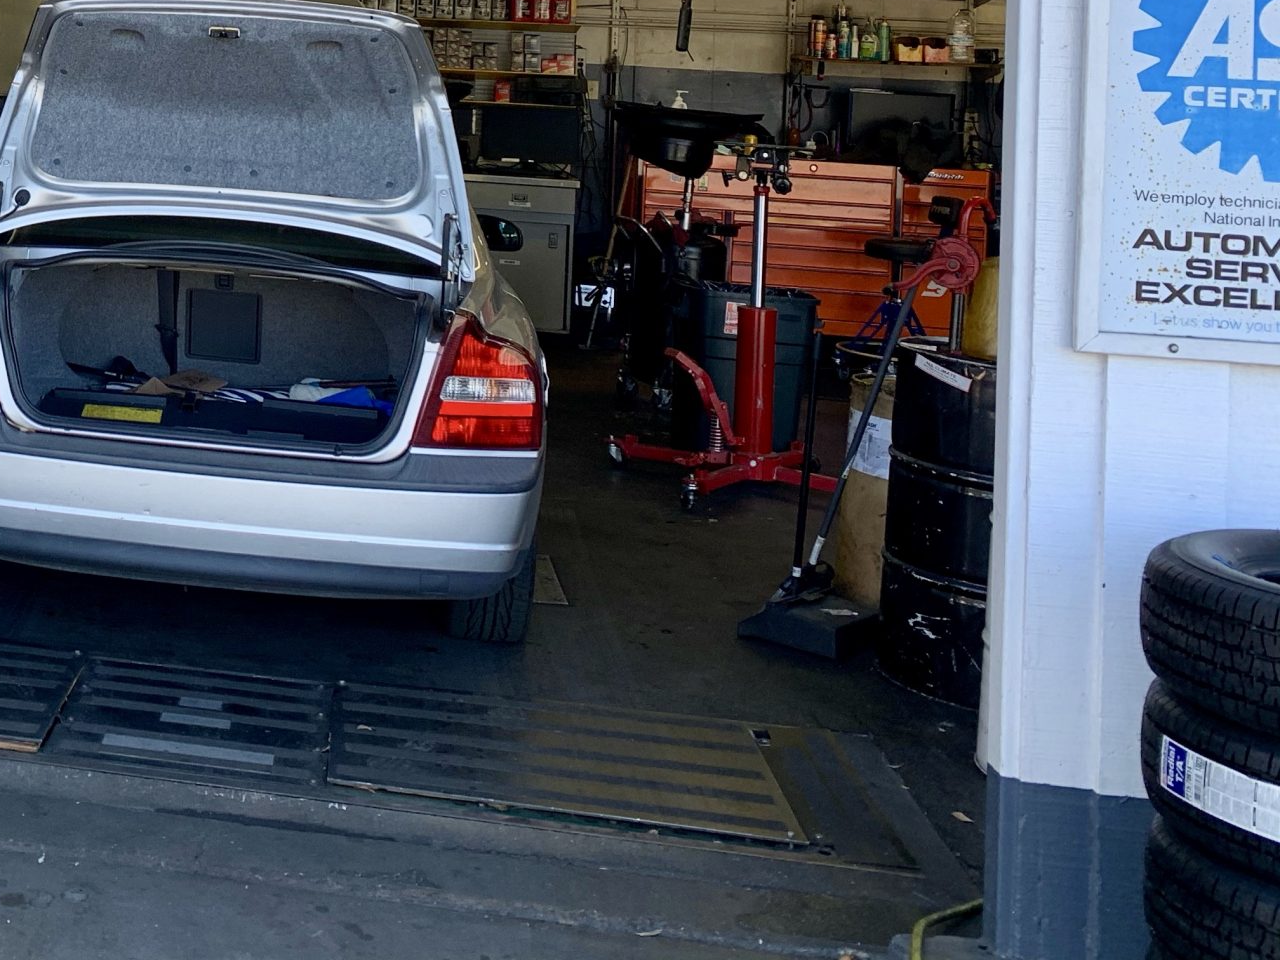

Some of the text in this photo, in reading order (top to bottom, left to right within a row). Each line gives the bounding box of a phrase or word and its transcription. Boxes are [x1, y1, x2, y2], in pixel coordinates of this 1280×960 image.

[1183, 86, 1280, 111] CERT
[1135, 189, 1159, 203] We
[1161, 193, 1215, 208] employ
[1204, 211, 1265, 227] National
[1203, 314, 1243, 330] show
[1247, 319, 1274, 333] you
[1167, 746, 1176, 787] Radial
